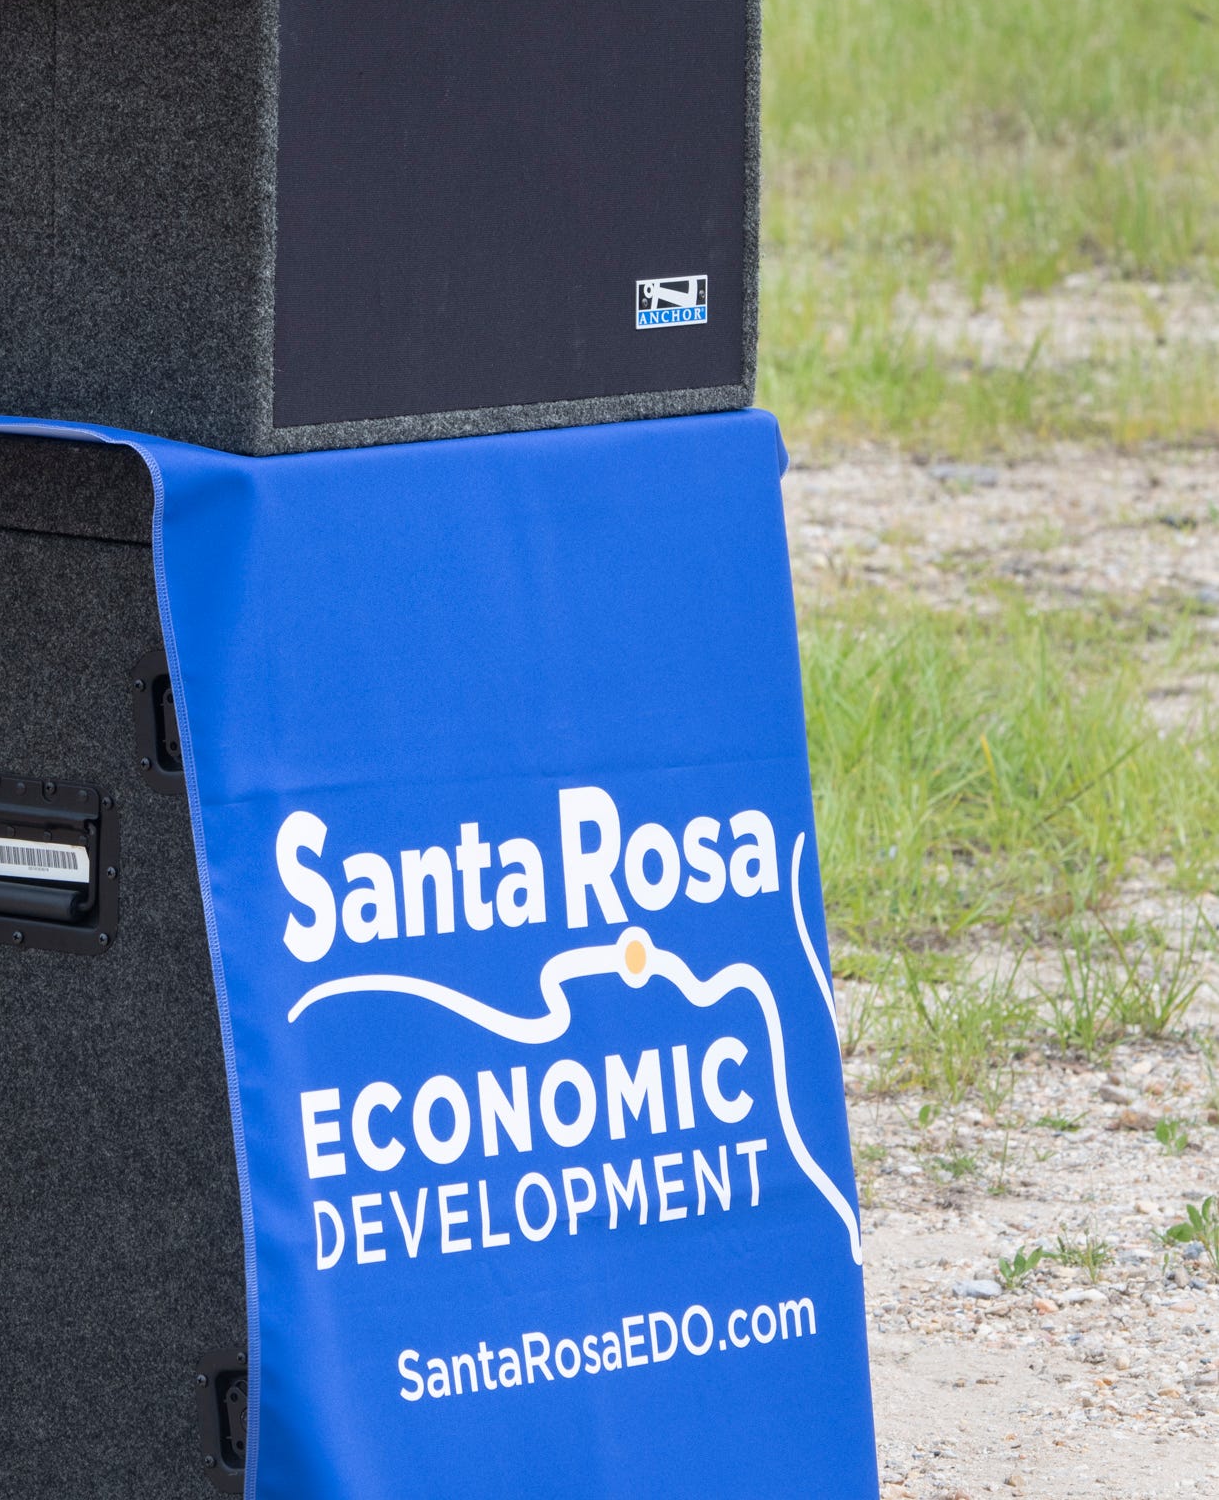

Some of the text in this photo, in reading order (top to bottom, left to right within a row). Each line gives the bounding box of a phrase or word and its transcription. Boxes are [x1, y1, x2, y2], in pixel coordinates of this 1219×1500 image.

[639, 308, 702, 325] ANCHOR
[275, 785, 780, 963] Santa Rosa
[300, 1036, 754, 1180] ECONOMIC
[312, 1138, 768, 1271] DEVELOPMENT
[397, 1297, 817, 1402] SantaRosaEDO.com
